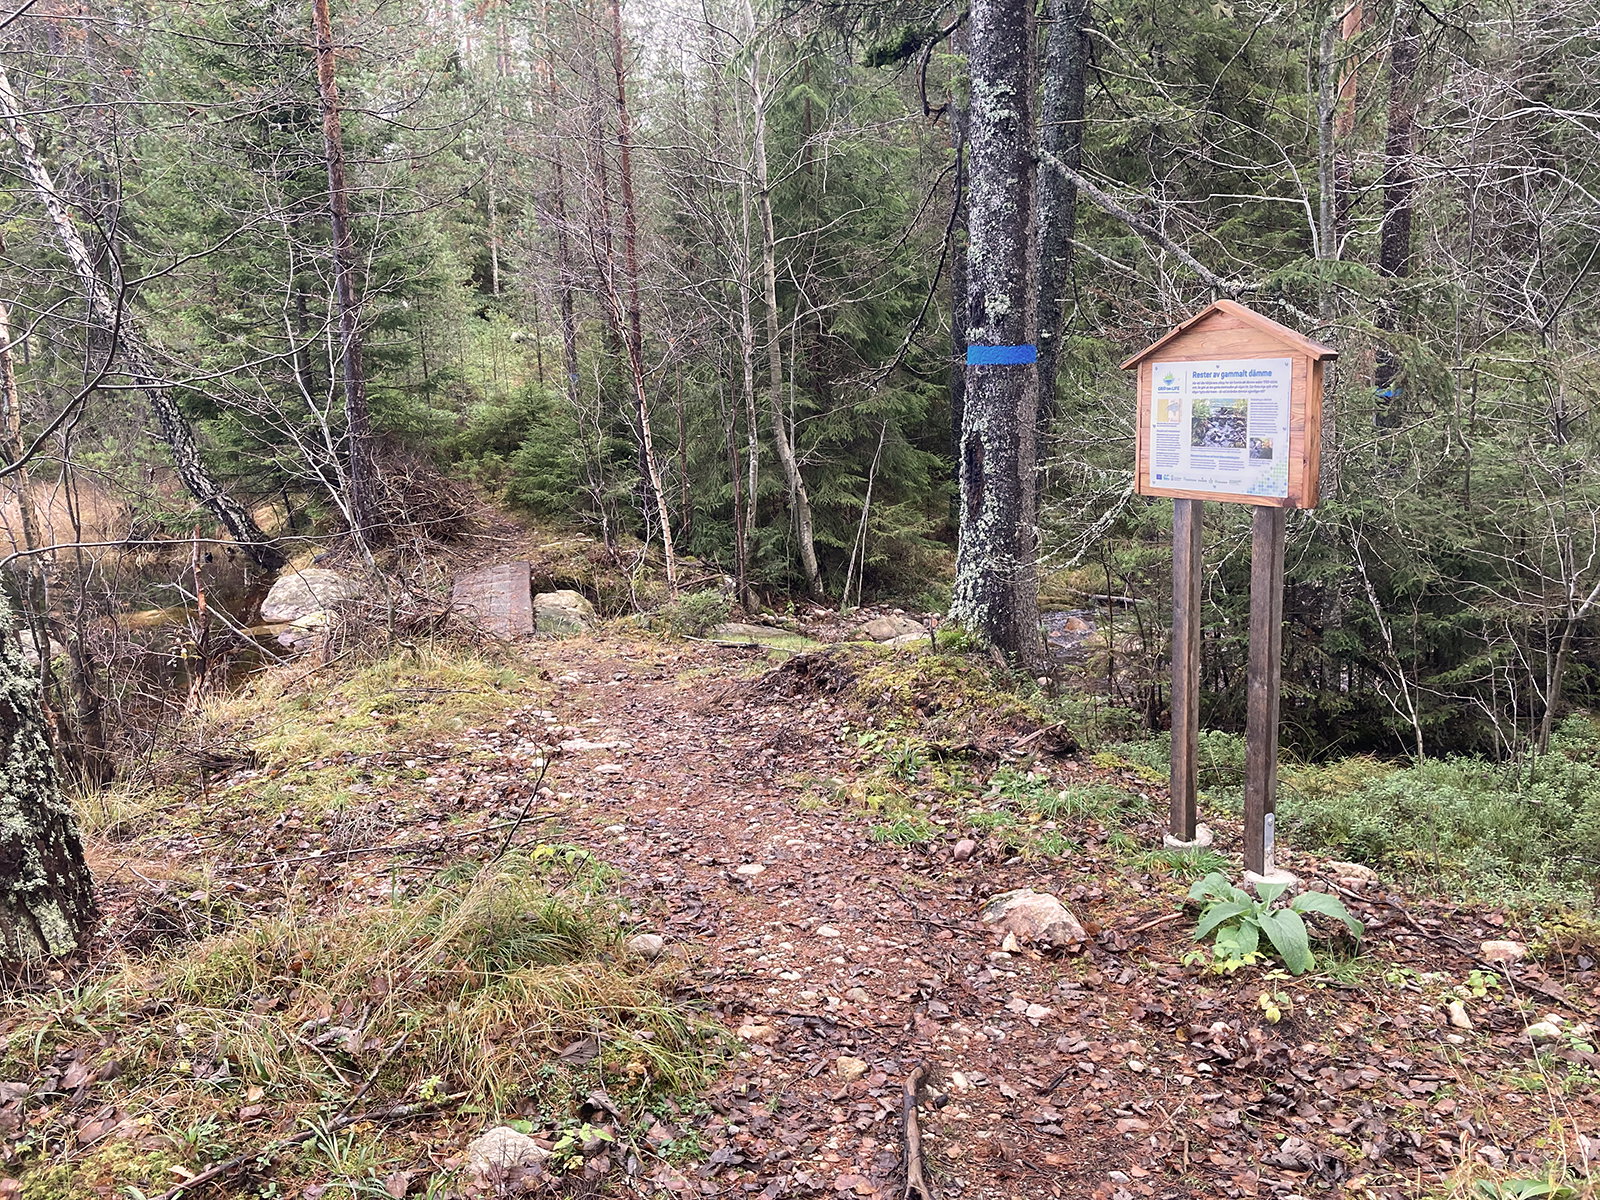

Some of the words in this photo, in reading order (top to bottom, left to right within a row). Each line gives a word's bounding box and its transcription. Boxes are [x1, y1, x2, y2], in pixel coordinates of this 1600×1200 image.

[1192, 371, 1212, 379] Rester
[1221, 370, 1248, 380] gammalt
[1248, 369, 1273, 377] dämme
